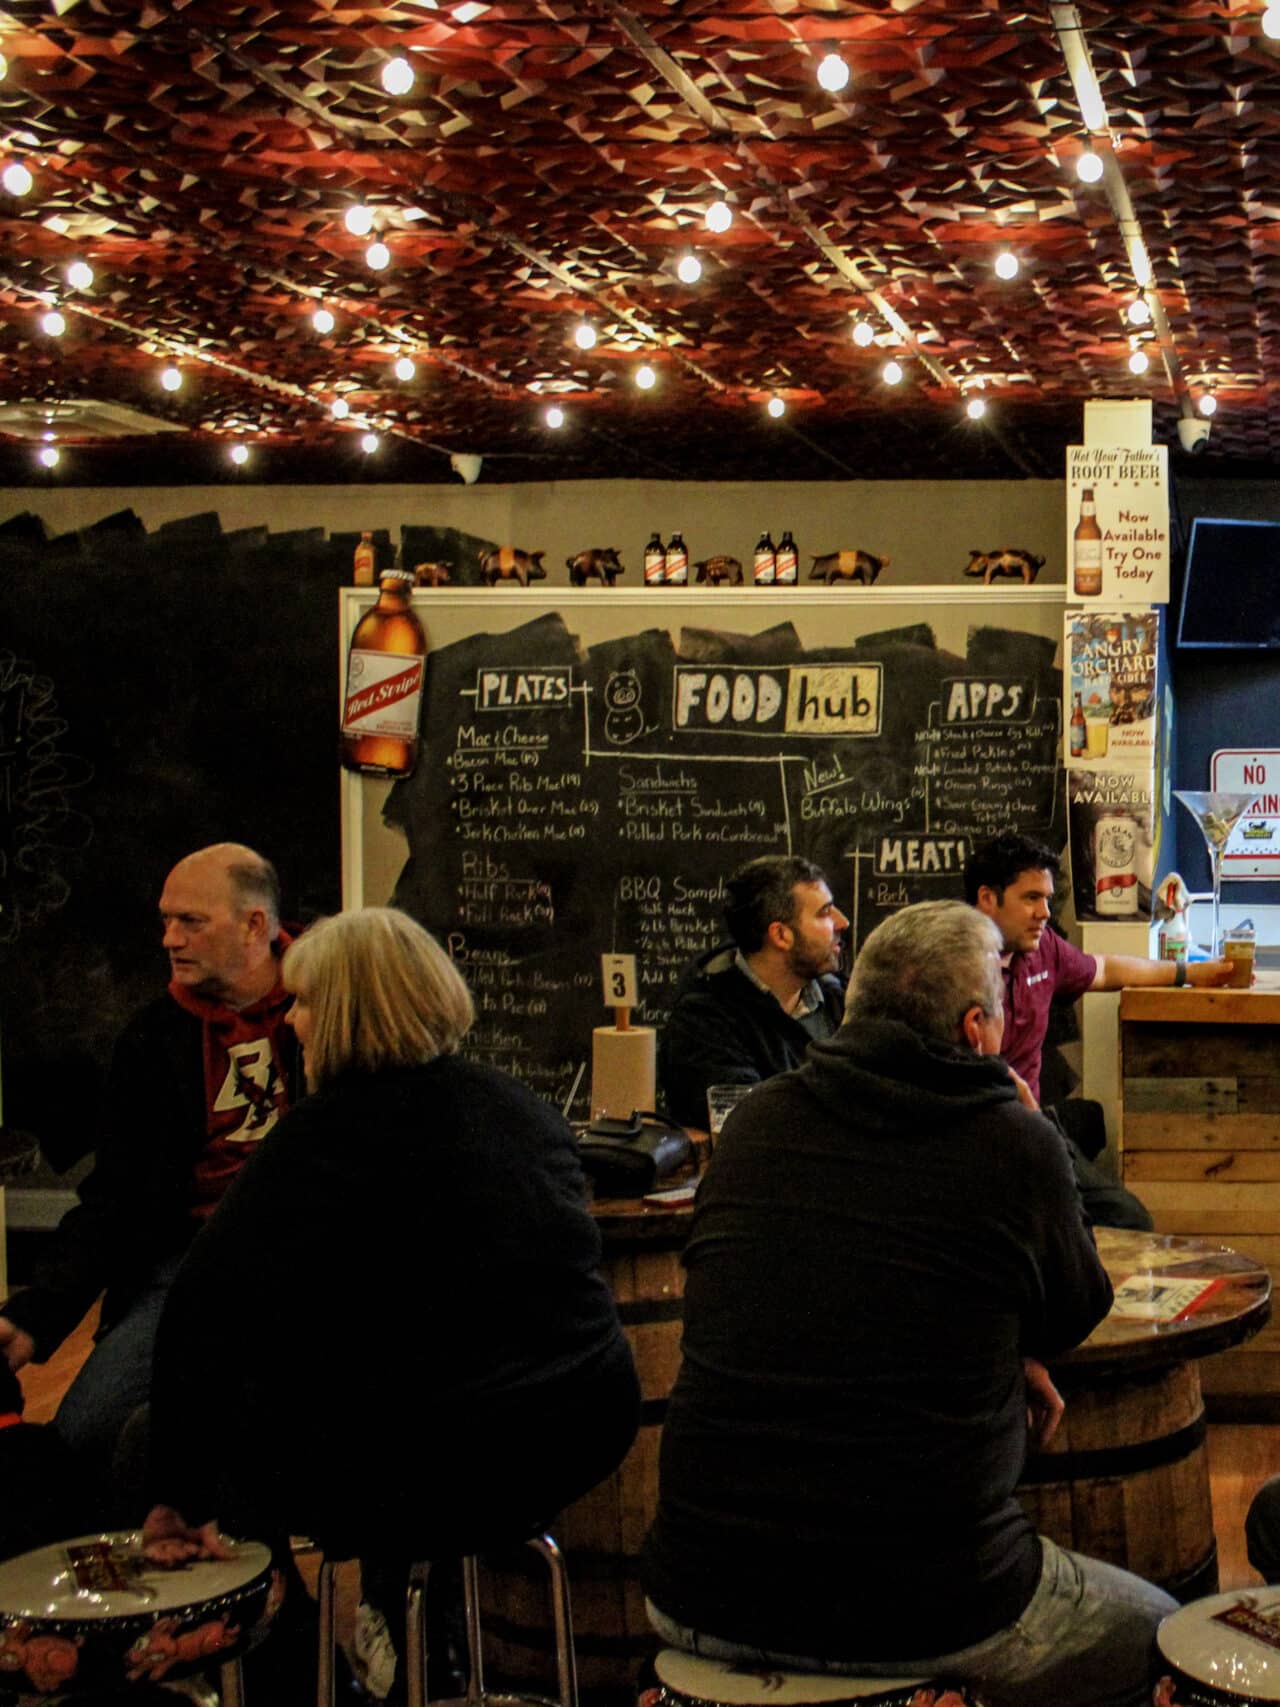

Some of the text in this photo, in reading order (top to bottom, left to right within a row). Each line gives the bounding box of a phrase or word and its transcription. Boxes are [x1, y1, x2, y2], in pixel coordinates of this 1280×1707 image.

[1093, 448, 1118, 465] Your
[1072, 465, 1160, 479] ROOT BEER
[1119, 510, 1149, 523] Now
[1104, 528, 1165, 541] Available
[1106, 547, 1162, 564] Try One
[1115, 565, 1153, 584] Today
[1083, 639, 1142, 658] ANGRY
[1072, 654, 1156, 676] ORCHARD
[1117, 672, 1147, 684] CIDER
[348, 673, 420, 718] Red Stripe
[482, 672, 569, 707] PLATES
[677, 673, 871, 727] FOOD hub
[947, 682, 1023, 721] APPS
[457, 725, 491, 748] Mac
[503, 725, 550, 745] Cheese
[457, 773, 469, 792] 3
[509, 772, 533, 792] Rib
[537, 775, 560, 791] Mac
[804, 754, 846, 792] New!
[1095, 776, 1136, 788] NOW
[1243, 765, 1266, 785] NO
[625, 795, 683, 817] Brisket
[801, 796, 857, 820] Buffalo
[861, 791, 911, 823] Wings
[626, 821, 665, 841] Pulled
[672, 822, 702, 841] Pork
[462, 851, 509, 879] Ribs
[880, 837, 965, 872] MEAT!
[621, 875, 662, 901] BBQ
[877, 880, 909, 904] Pork
[612, 971, 626, 998] 3
